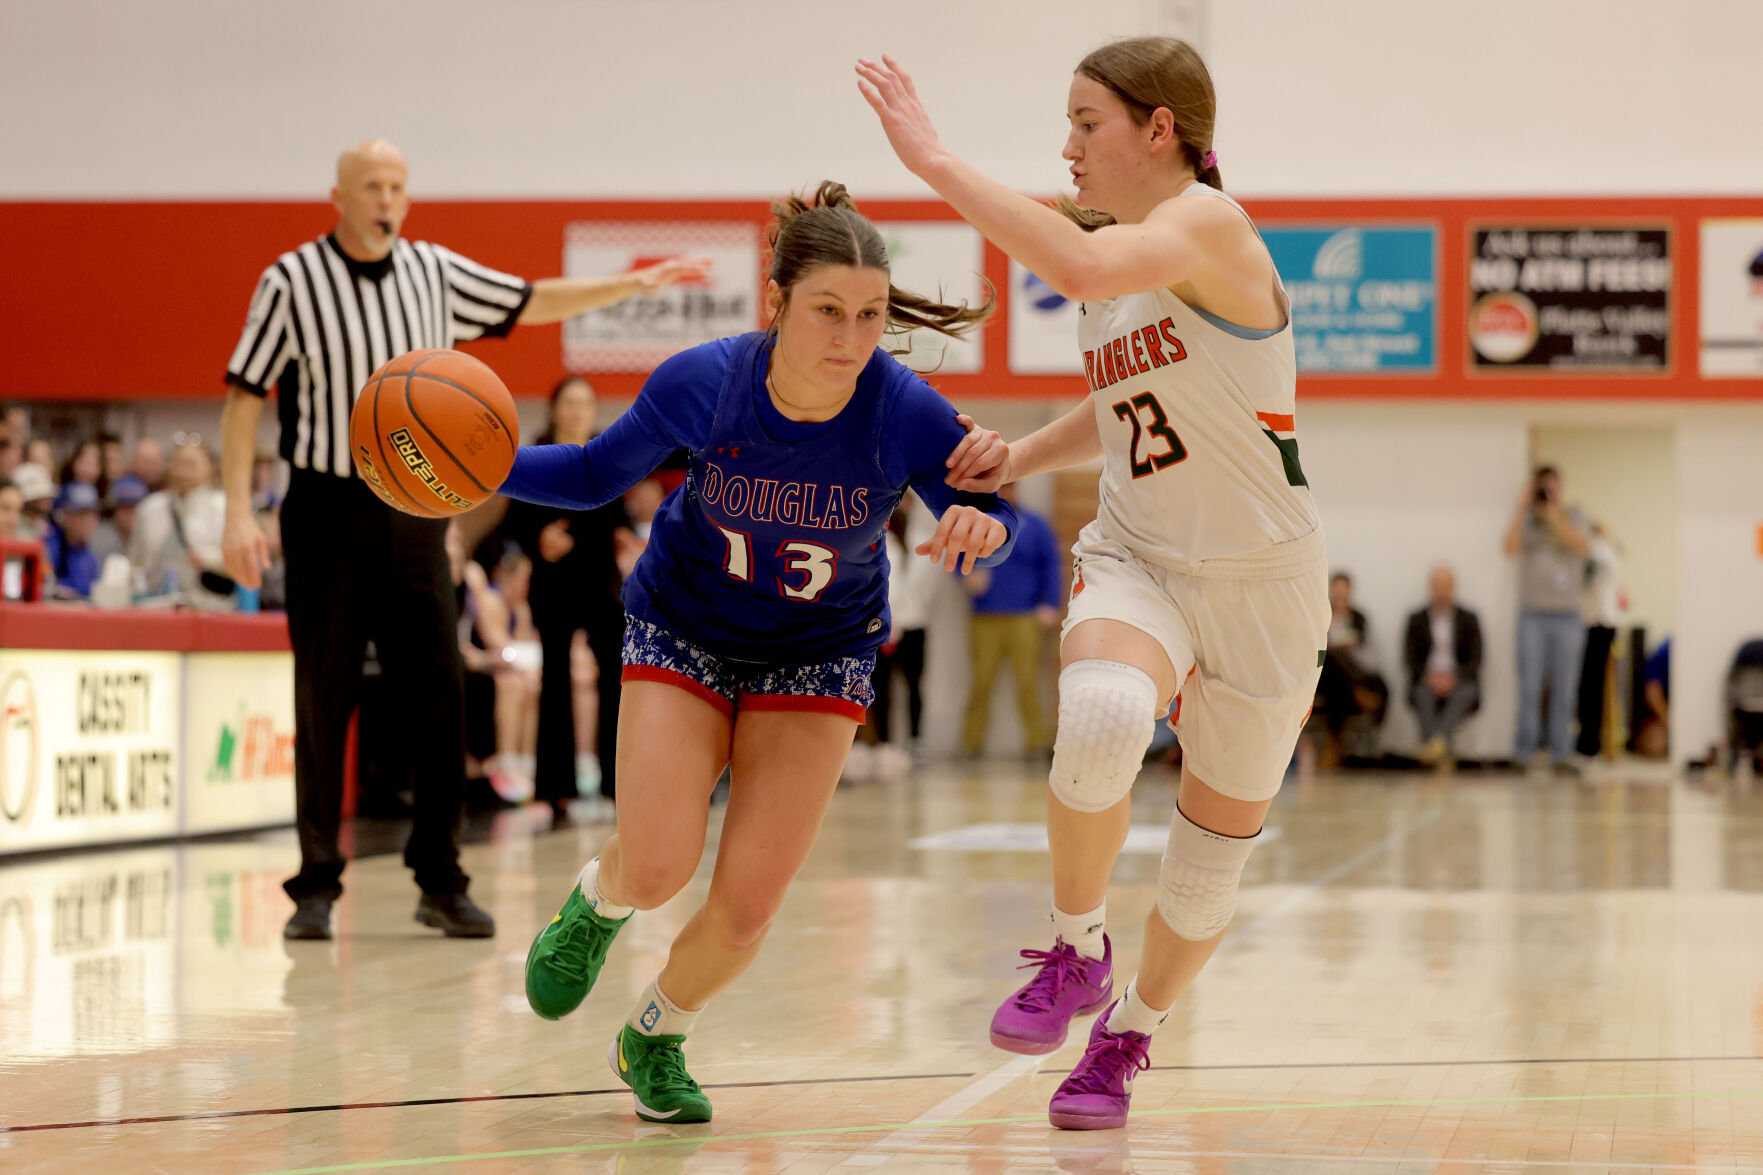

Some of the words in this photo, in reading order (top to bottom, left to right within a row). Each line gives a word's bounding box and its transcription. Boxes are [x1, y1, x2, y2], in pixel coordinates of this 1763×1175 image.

[1471, 257, 1519, 291] NO
[1083, 316, 1188, 392] RANGLERS
[1111, 391, 1188, 480] 23
[702, 462, 869, 530] DOUGLAS
[717, 525, 840, 602] 13
[77, 670, 152, 734] CASSITY
[55, 752, 120, 818] DENTAL
[128, 750, 172, 811] ARTS
